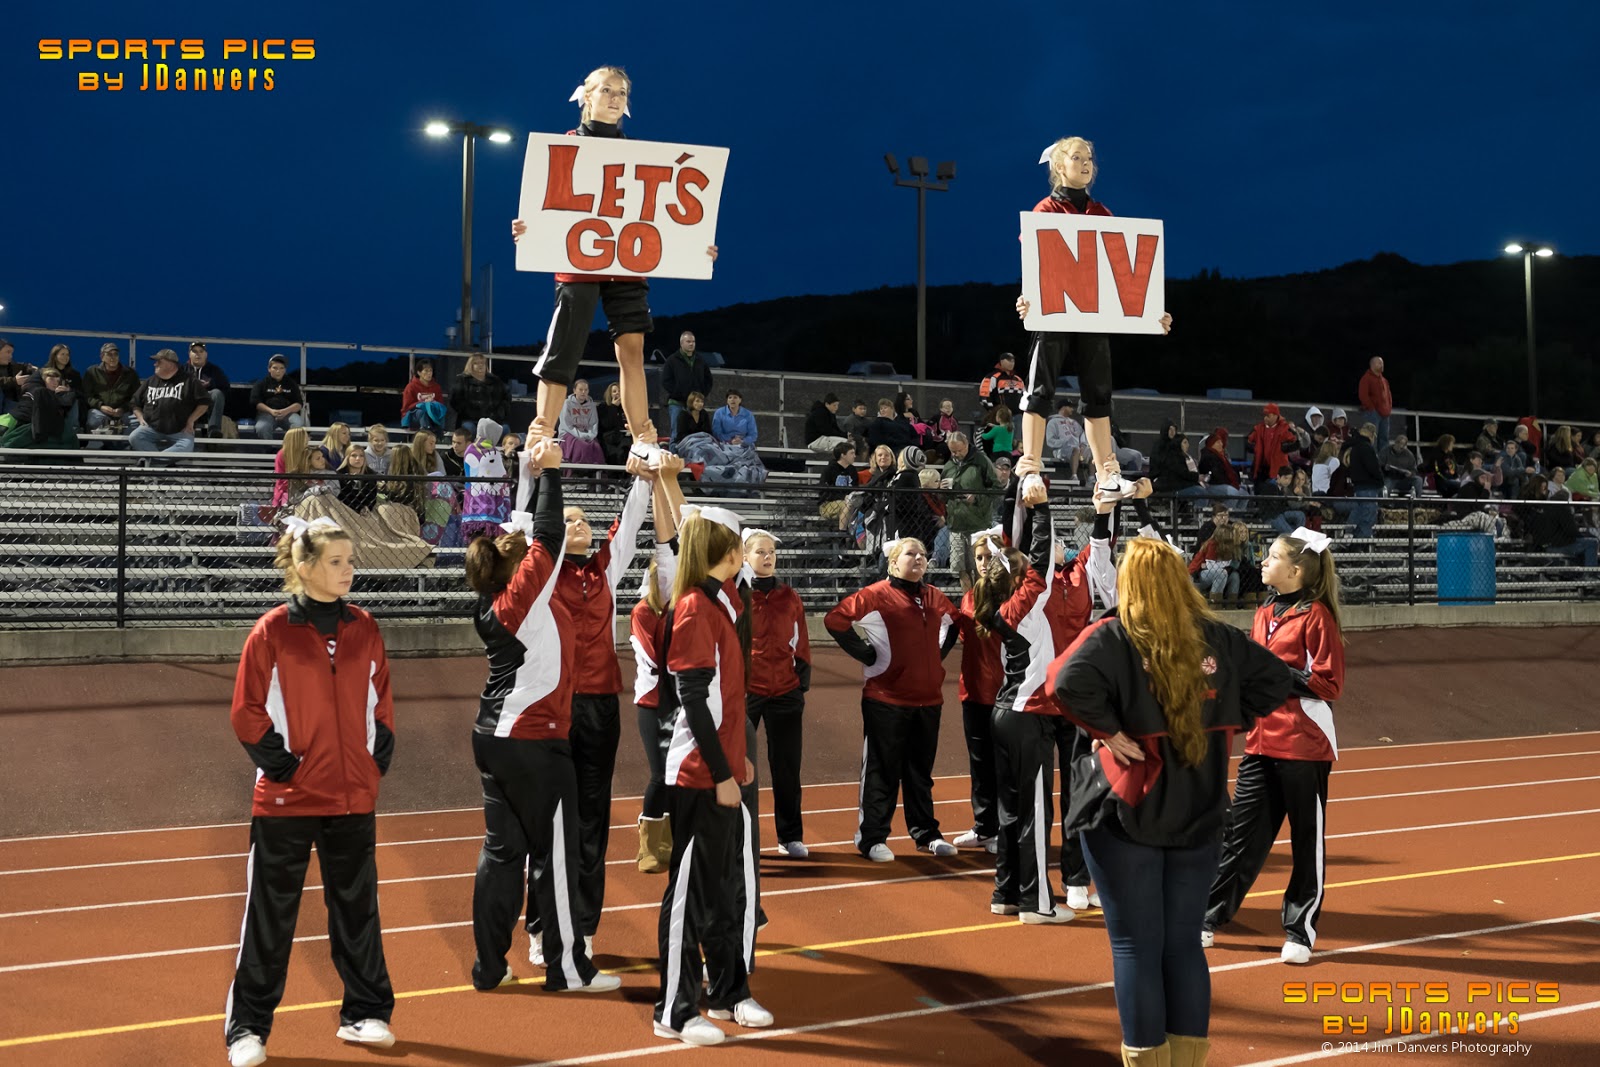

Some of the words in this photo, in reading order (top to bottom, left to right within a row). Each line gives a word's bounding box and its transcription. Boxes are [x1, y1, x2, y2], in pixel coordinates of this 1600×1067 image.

[541, 144, 710, 226] LET'S
[565, 217, 663, 273] GO
[1036, 228, 1160, 318] NV
